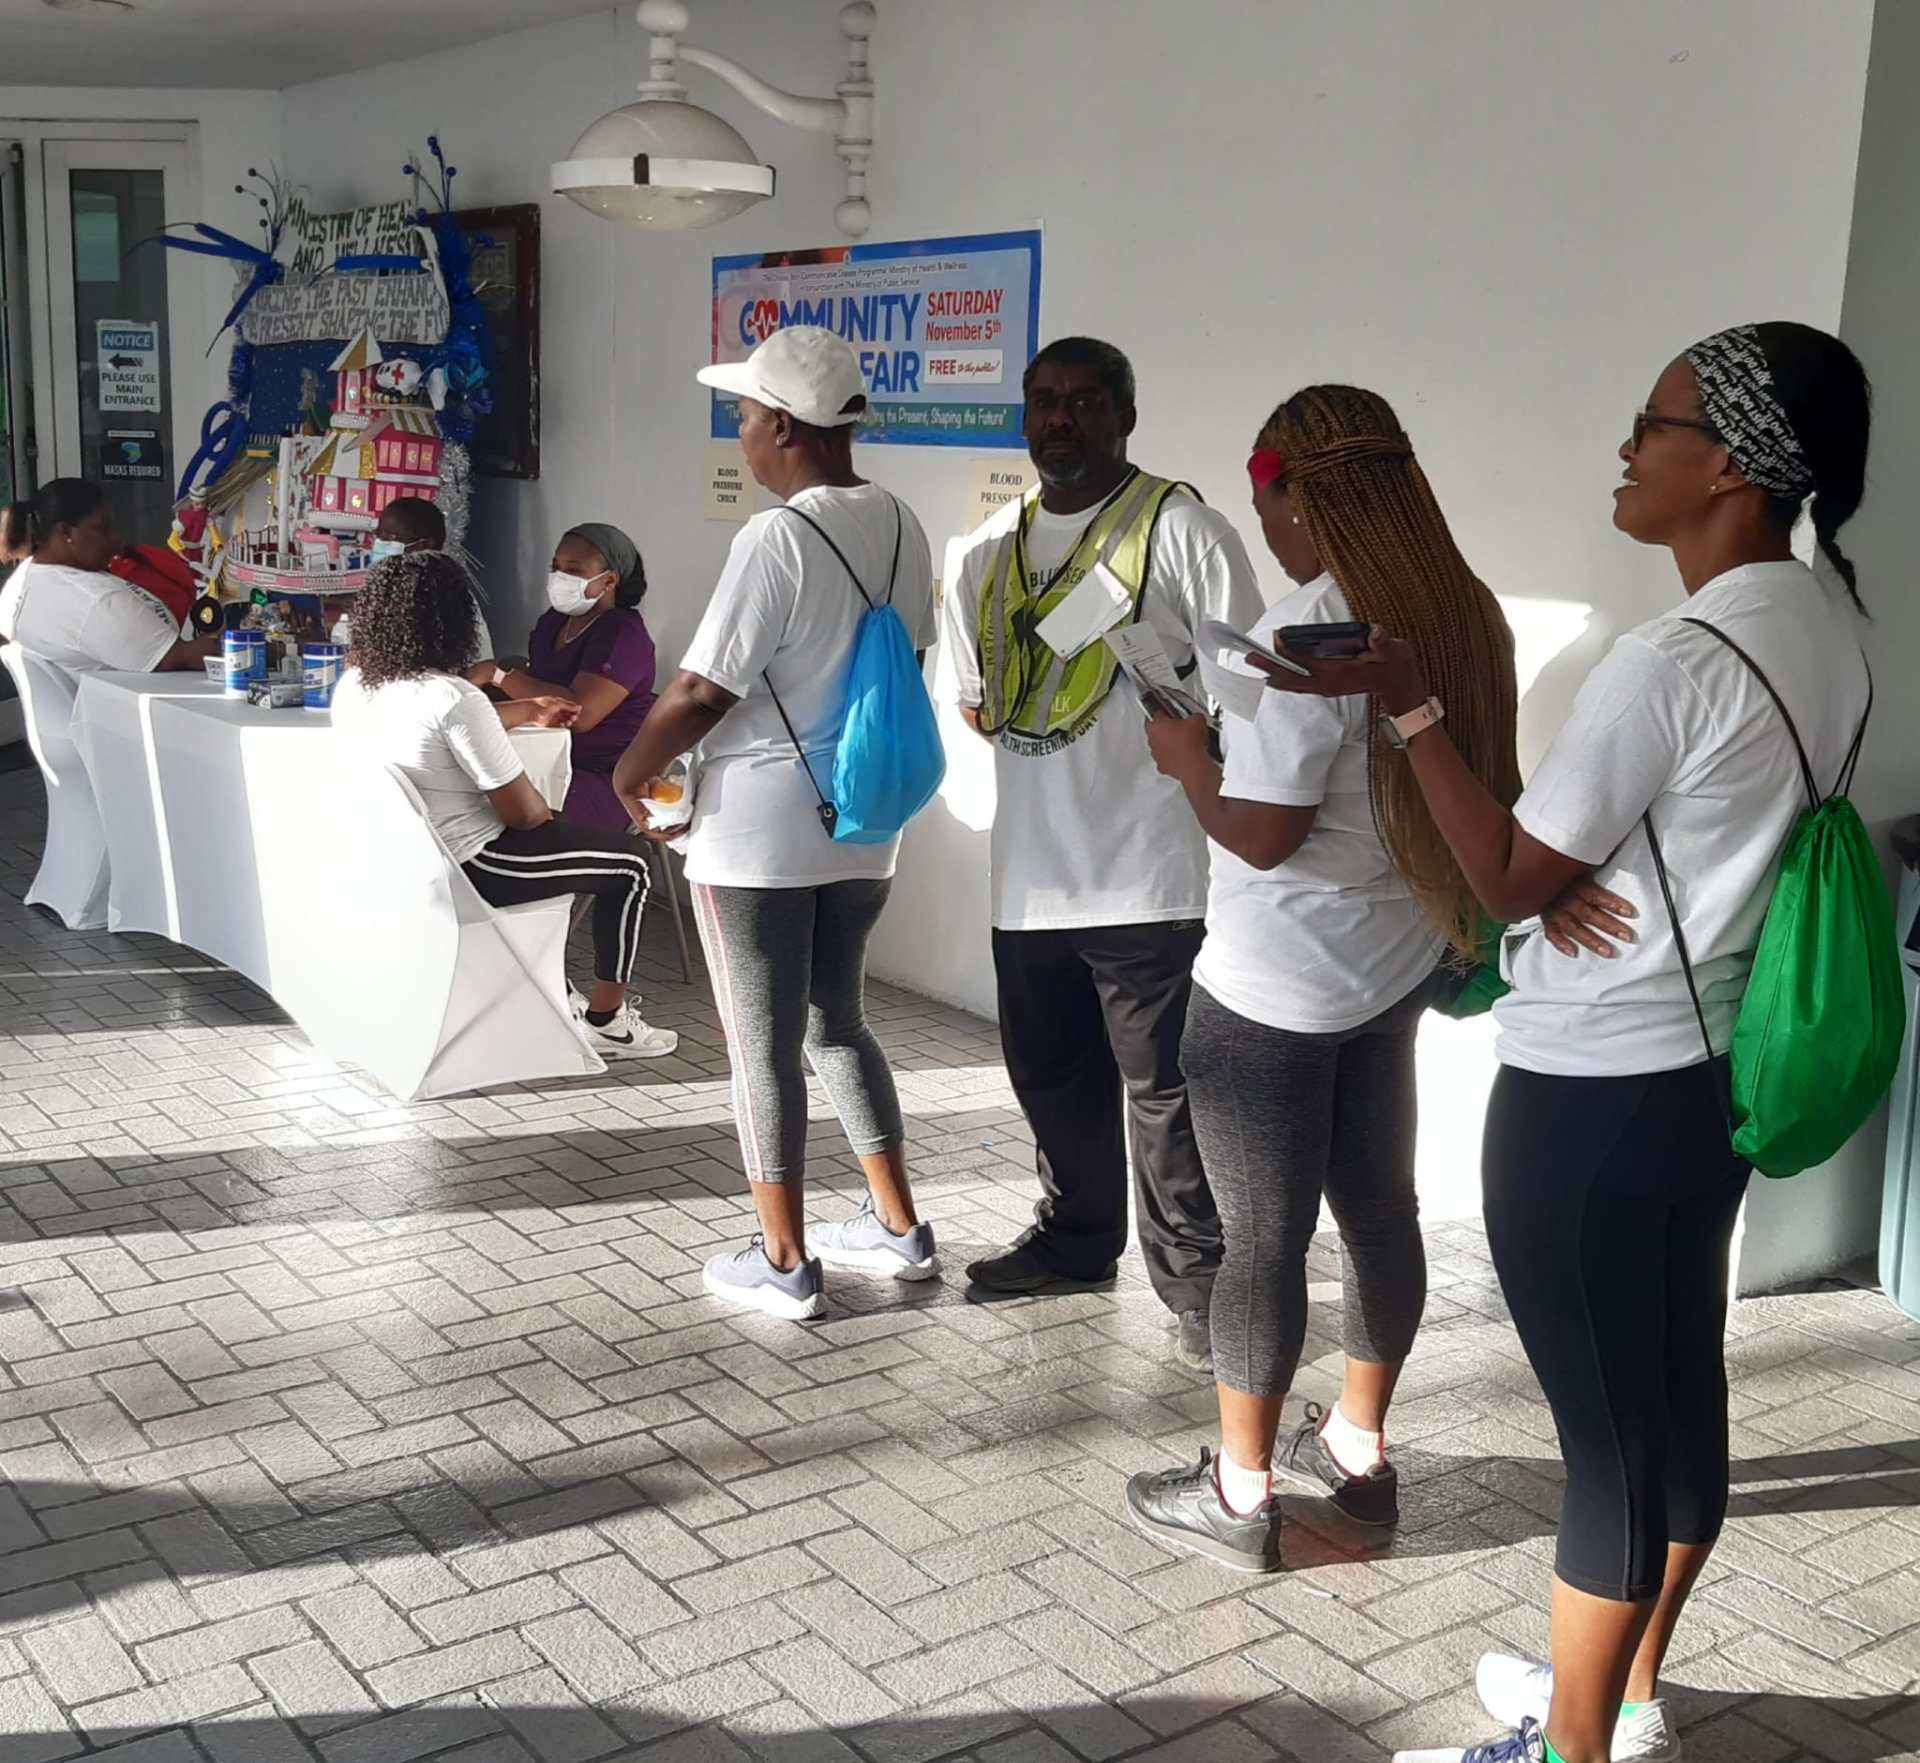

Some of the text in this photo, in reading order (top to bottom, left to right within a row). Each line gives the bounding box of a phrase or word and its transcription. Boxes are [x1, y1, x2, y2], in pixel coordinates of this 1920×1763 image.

[283, 197, 413, 245] MINISTRY OF HEA
[291, 244, 325, 274] AND
[337, 278, 373, 306] PAST
[927, 288, 1003, 317] SATURDAY
[389, 309, 418, 341] THE
[926, 319, 1003, 342] November 5th
[103, 334, 151, 347] NOTICE
[929, 359, 957, 375] FREE
[1743, 357, 1757, 369] DO
[102, 373, 156, 383] PLEASE USE
[860, 351, 920, 393] FAIR
[1713, 369, 1726, 384] DO
[116, 385, 143, 393] MAIN
[1718, 382, 1737, 403] JUST
[104, 395, 156, 405] ENTRANCE
[1740, 395, 1754, 410] DO
[931, 406, 961, 429] Shaping
[964, 408, 976, 425] the
[978, 408, 1008, 426] Future"
[1705, 400, 1740, 447] JUST DO IT.
[1747, 408, 1768, 430] JUST
[1769, 421, 1783, 436] DO
[1742, 439, 1757, 453] DO
[104, 465, 161, 477] MASKS REQUIRED
[718, 468, 739, 477] BLOOD
[990, 472, 1023, 485] BLOOD
[1021, 728, 1076, 757] SCREENING
